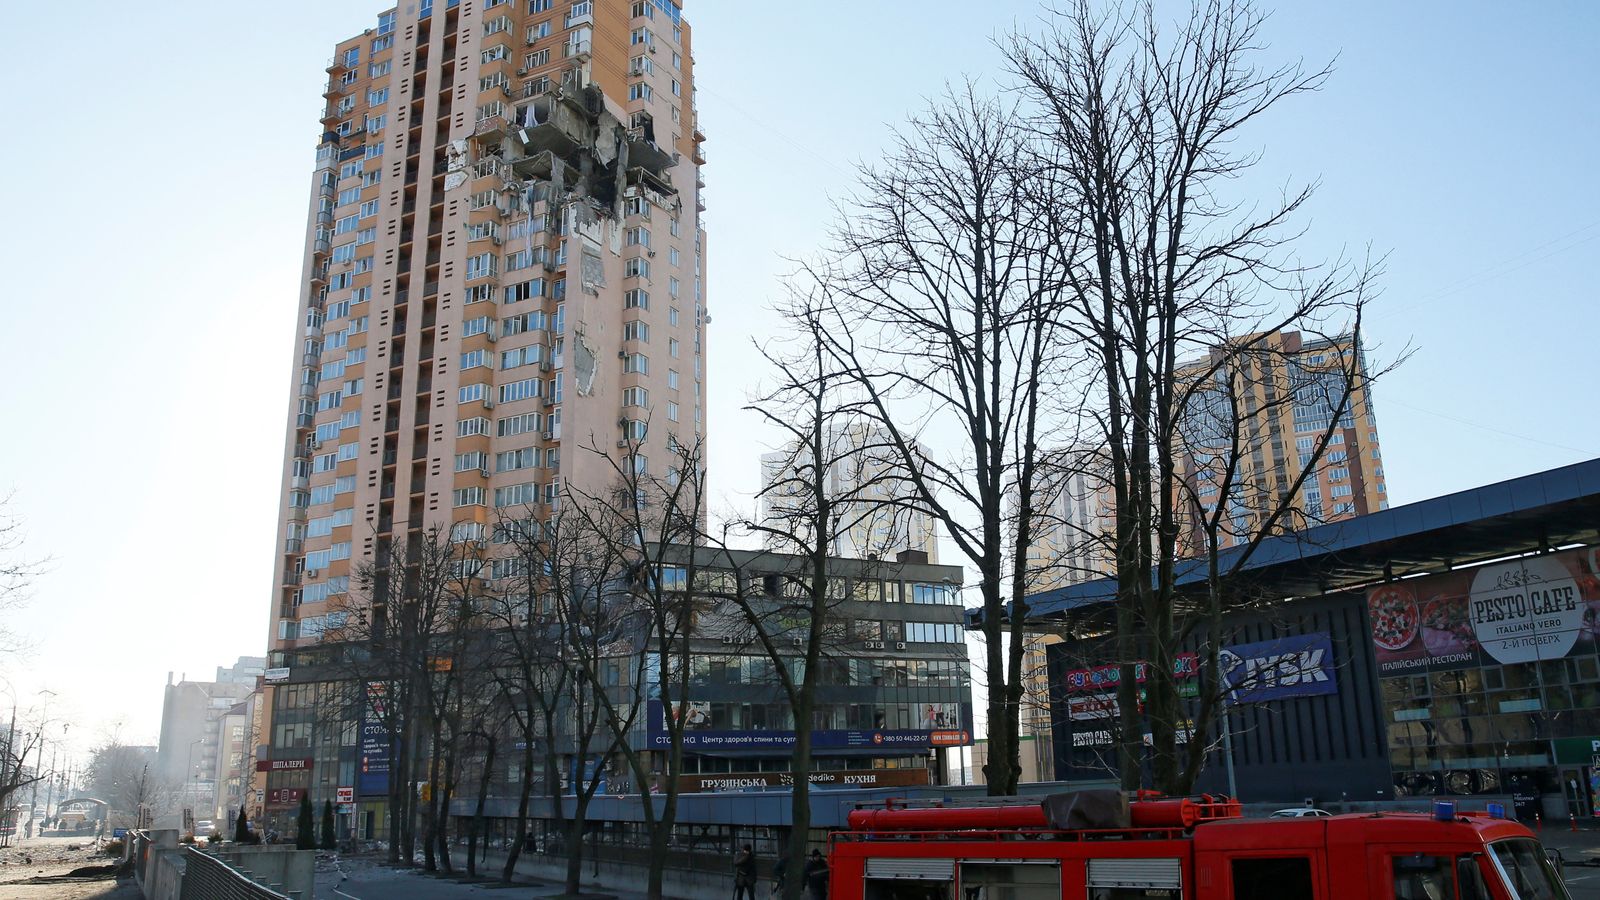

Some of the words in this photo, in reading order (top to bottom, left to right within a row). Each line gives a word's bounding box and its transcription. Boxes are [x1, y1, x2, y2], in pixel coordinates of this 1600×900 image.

[1474, 594, 1526, 624] PESTO
[1531, 586, 1576, 616] CAFE
[1496, 623, 1535, 635] ITALIANO
[1538, 619, 1561, 628] VERO
[1522, 634, 1560, 647] ПОВЕРХ
[1431, 652, 1473, 666] РЕСТОРАН
[1242, 648, 1328, 691] JYSK
[702, 736, 723, 744] Центр
[1073, 732, 1093, 746] PESTO
[272, 760, 305, 769] ШПАЛЕРИ
[701, 778, 767, 788] ГРУЗИНСЬКА
[844, 774, 876, 784] КУХНЯ
